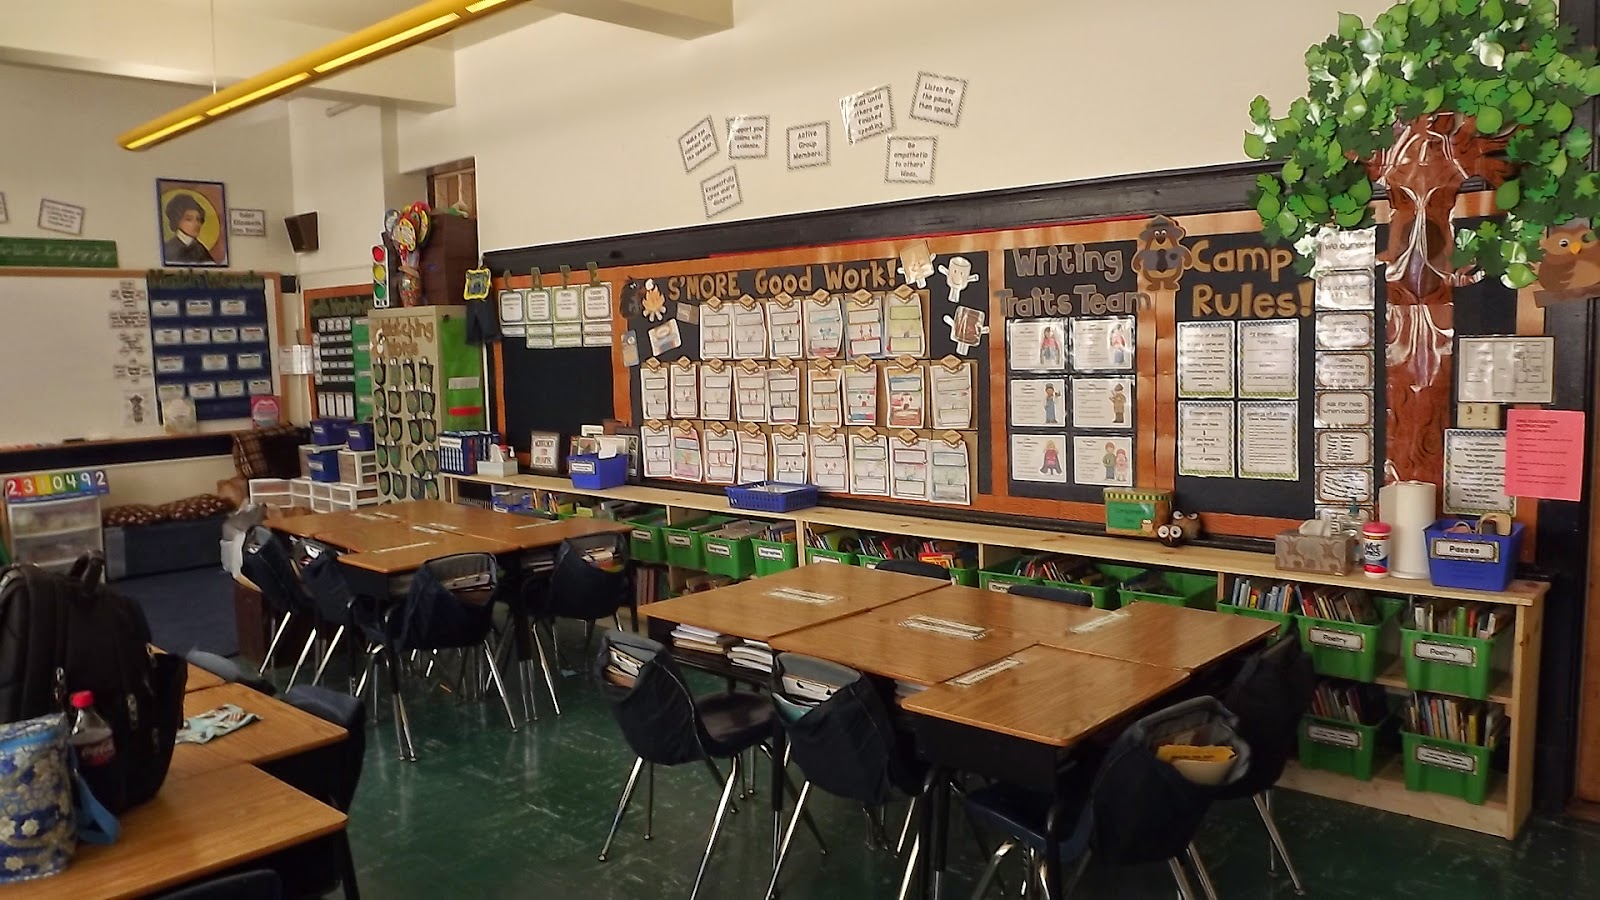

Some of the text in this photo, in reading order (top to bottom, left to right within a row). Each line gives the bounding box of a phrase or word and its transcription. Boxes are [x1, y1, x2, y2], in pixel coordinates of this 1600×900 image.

[922, 92, 933, 101] the
[1013, 244, 1123, 282] Writing
[1191, 240, 1293, 283] Camp
[668, 258, 897, 300] S'MORE Good Work!
[994, 284, 1151, 317] Traits Team
[1192, 281, 1315, 318] Rules!
[1450, 545, 1480, 555] Passes
[1323, 634, 1348, 644] Poetry
[1429, 648, 1456, 658] Poetry
